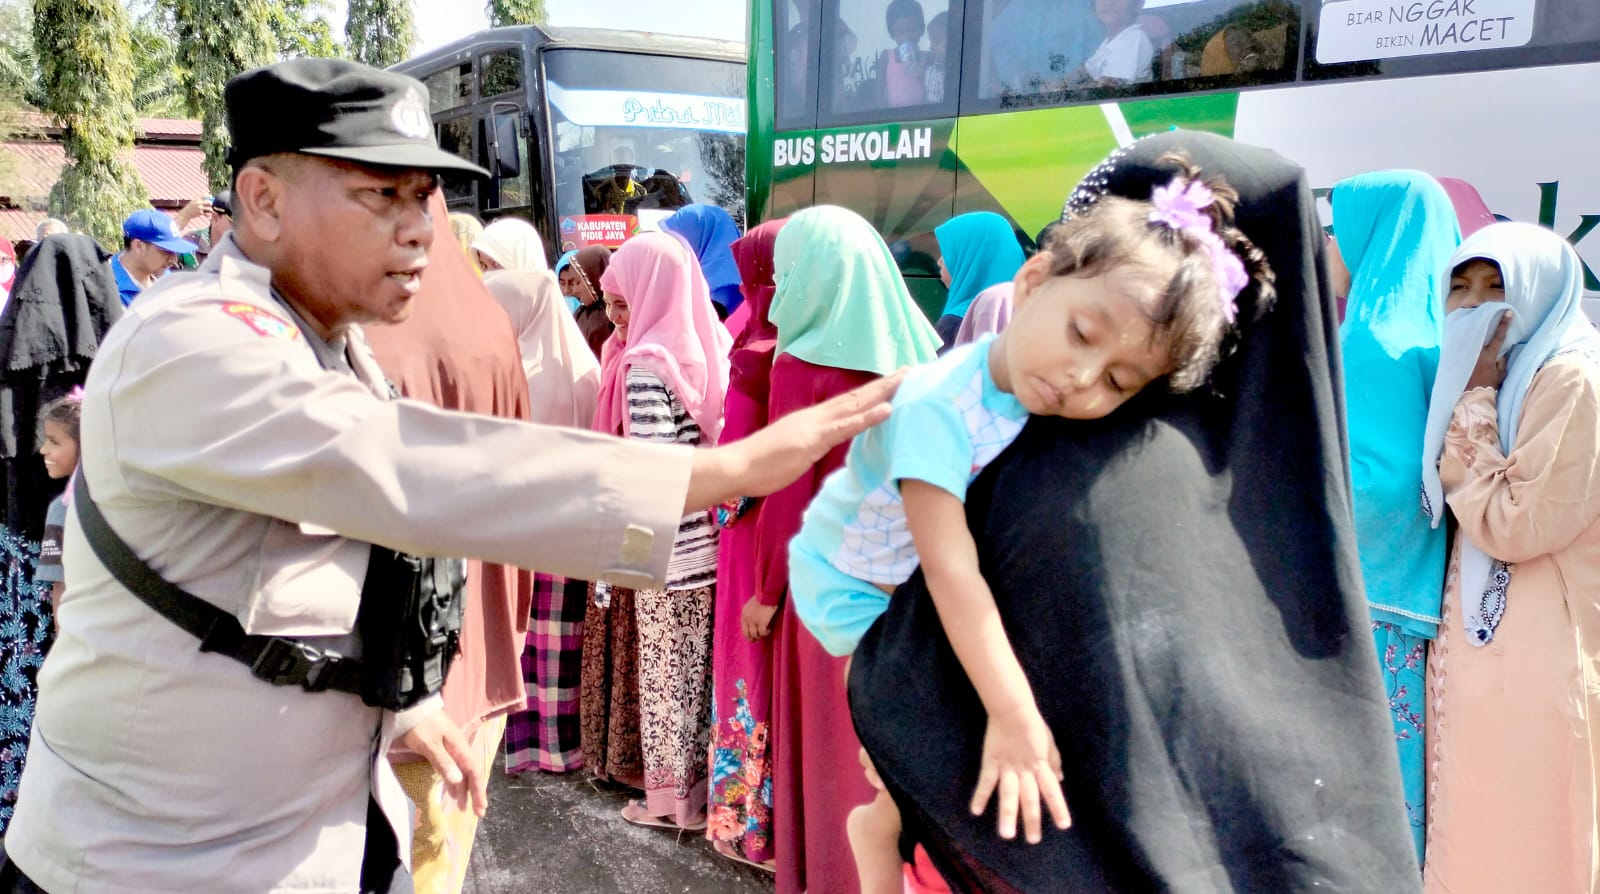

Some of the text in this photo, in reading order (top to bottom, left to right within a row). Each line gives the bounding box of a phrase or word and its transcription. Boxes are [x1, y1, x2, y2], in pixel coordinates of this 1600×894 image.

[1346, 0, 1475, 26] BIAR NGGAK
[1375, 16, 1514, 48] BIKIN MACET
[622, 98, 700, 123] Putra
[774, 127, 932, 167] BUS SEKOLAH
[577, 221, 626, 231] KABUPATEN
[581, 231, 625, 240] PIDIE JAYA
